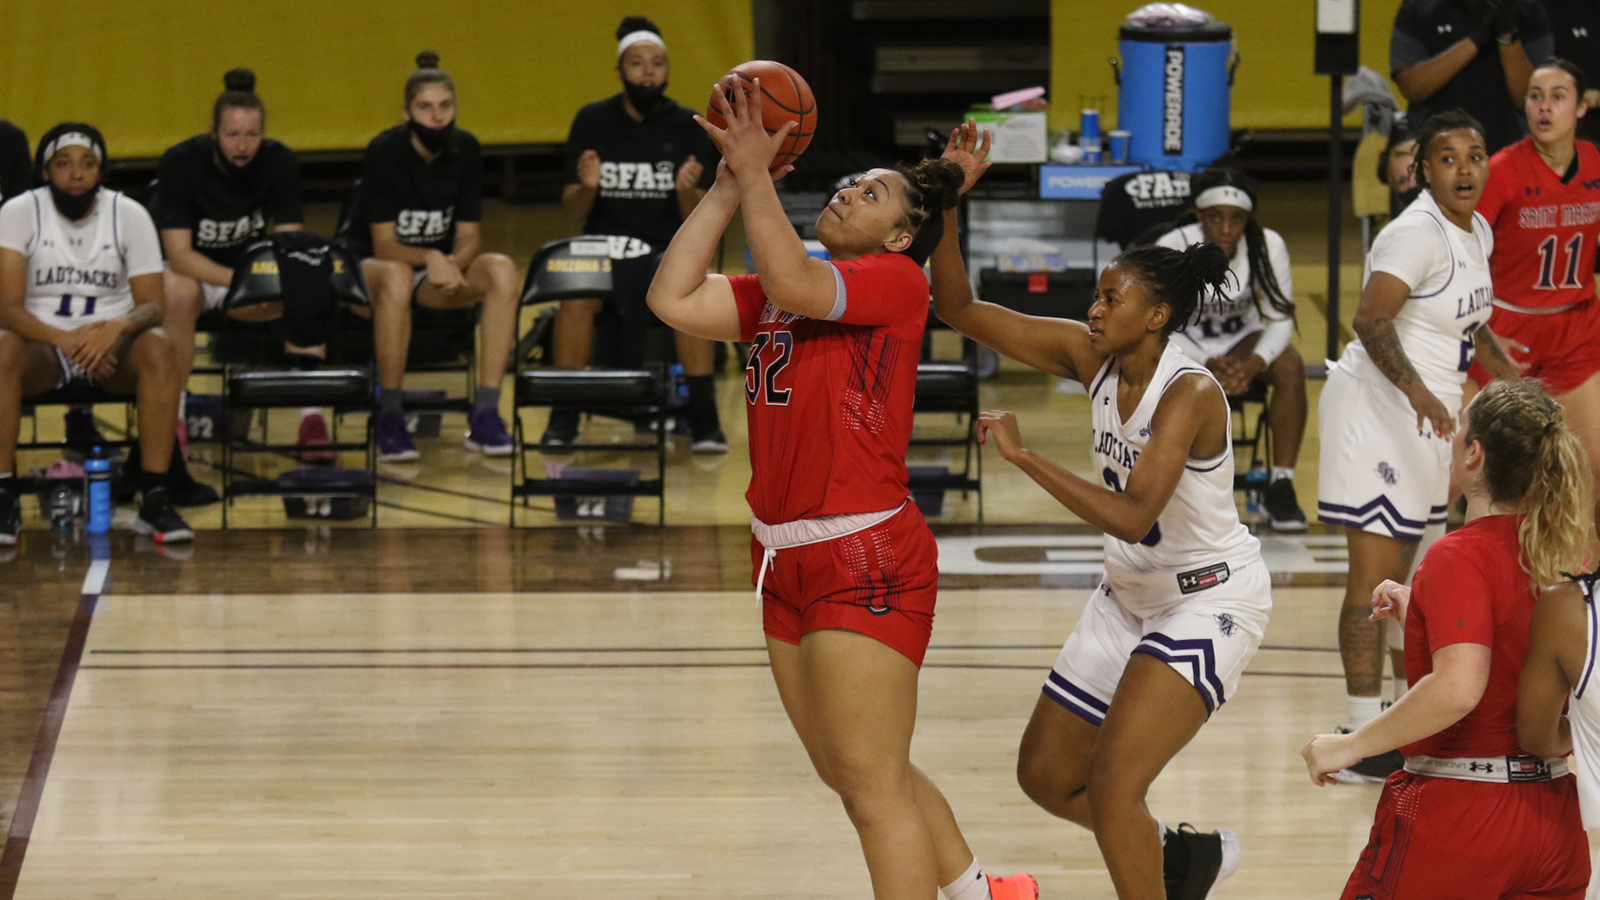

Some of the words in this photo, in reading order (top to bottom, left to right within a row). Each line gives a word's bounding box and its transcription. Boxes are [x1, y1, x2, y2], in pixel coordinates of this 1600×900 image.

[1165, 50, 1183, 151] POWERADE
[600, 161, 656, 190] SFA
[1048, 175, 1113, 189] POWER
[397, 208, 444, 235] SFA
[1519, 205, 1558, 229] SAINT
[1532, 231, 1583, 290] 11
[36, 266, 118, 289] LADYJACKS
[54, 294, 97, 317] 11
[744, 330, 793, 406] 32
